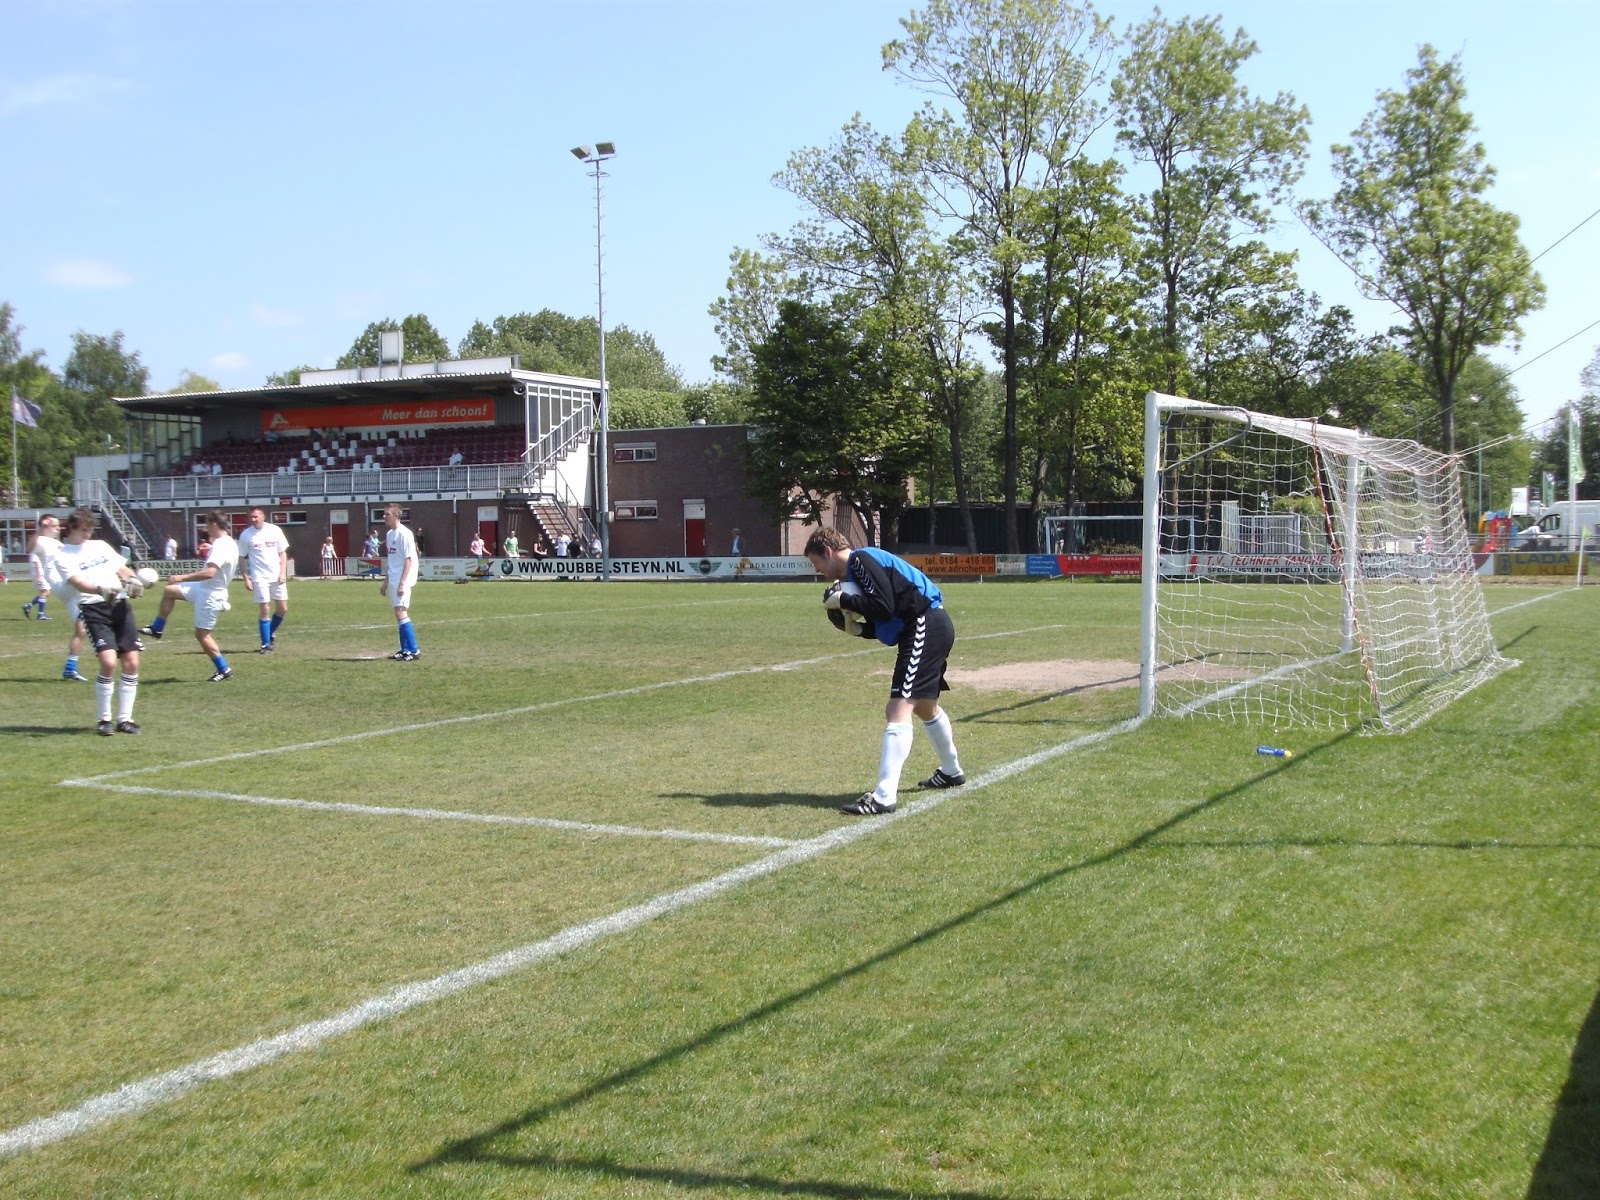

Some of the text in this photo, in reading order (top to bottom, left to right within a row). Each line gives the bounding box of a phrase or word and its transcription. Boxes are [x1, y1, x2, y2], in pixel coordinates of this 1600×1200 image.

[382, 404, 488, 420] Meer dan schoon!
[925, 556, 938, 565] tel.
[939, 556, 958, 565] 0184
[966, 556, 980, 565] 416
[1207, 556, 1225, 566] T.V.
[1230, 556, 1281, 566] TECHNIEK
[1515, 554, 1570, 565] LADA
[518, 561, 685, 574] WWW.DUBBESTEYN.NL
[927, 565, 996, 573] www.adrichem.nl
